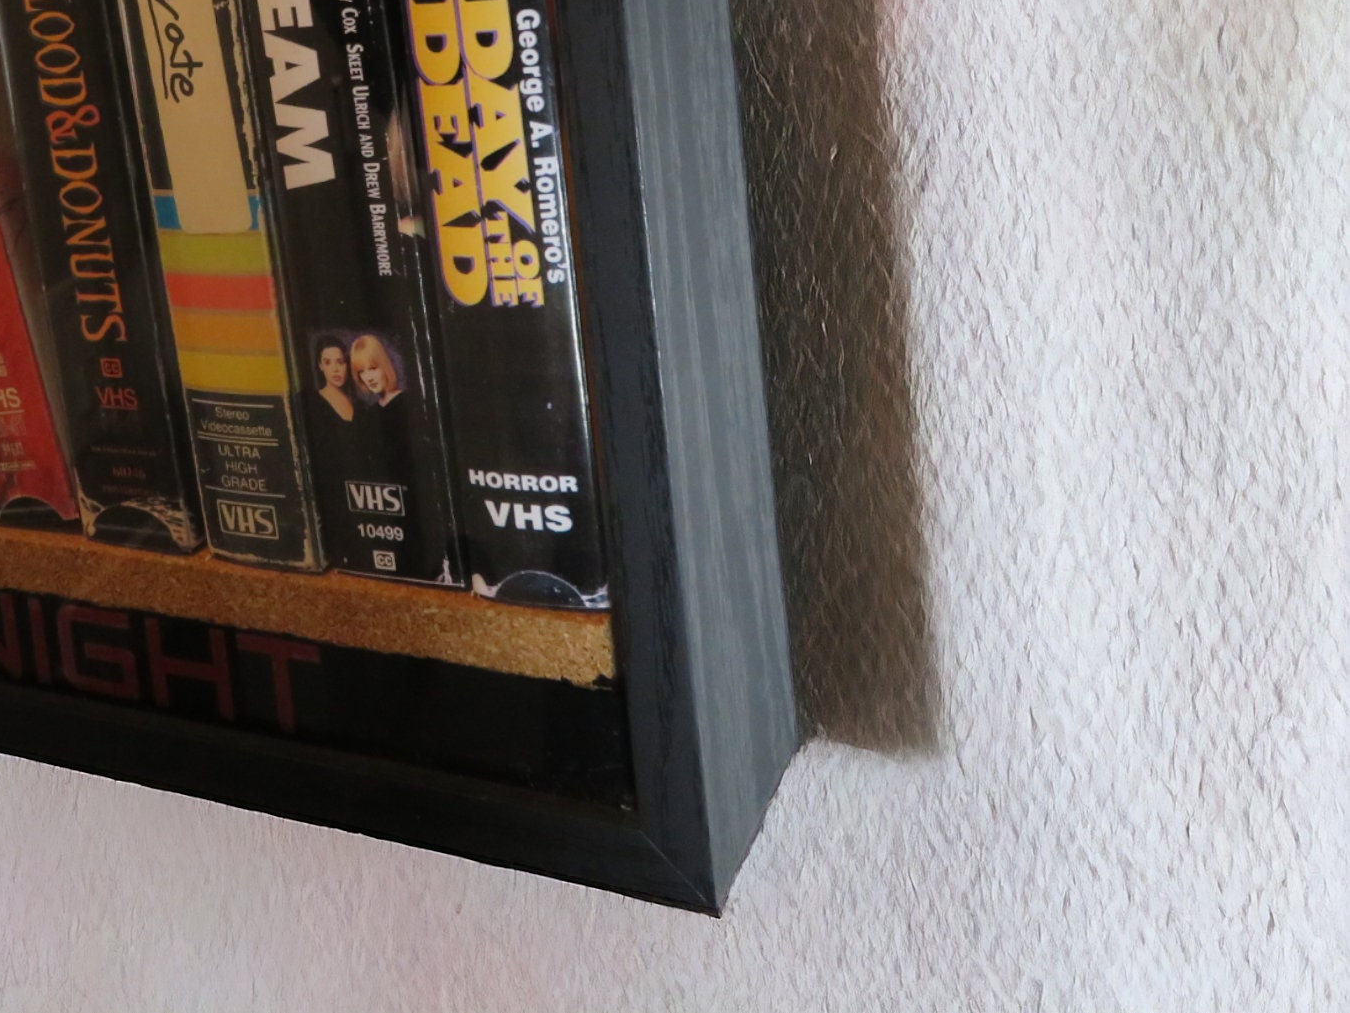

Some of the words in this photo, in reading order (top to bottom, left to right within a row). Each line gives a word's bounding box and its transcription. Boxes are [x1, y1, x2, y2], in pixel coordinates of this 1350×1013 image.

[341, 7, 359, 34] COX
[346, 43, 364, 81] SKEET
[516, 8, 545, 113] George
[352, 86, 370, 130] ULRICH
[358, 133, 374, 158] AND
[529, 120, 553, 148] A.
[363, 161, 381, 199] DREW
[534, 156, 565, 284] Romero's
[369, 203, 392, 277] BARRYMORE
[483, 210, 519, 307] THE
[513, 239, 545, 307] OF
[95, 386, 138, 408] VHS
[215, 406, 249, 421] Stereo
[200, 419, 273, 437] Videocassette
[217, 443, 261, 460] ULTRA
[225, 461, 258, 475] HIGH
[468, 469, 578, 493] HORROR
[221, 474, 267, 492] GRADE
[348, 484, 403, 513] VHS
[220, 503, 274, 535] VHS
[484, 500, 574, 533] VHS
[357, 523, 405, 542] 10499
